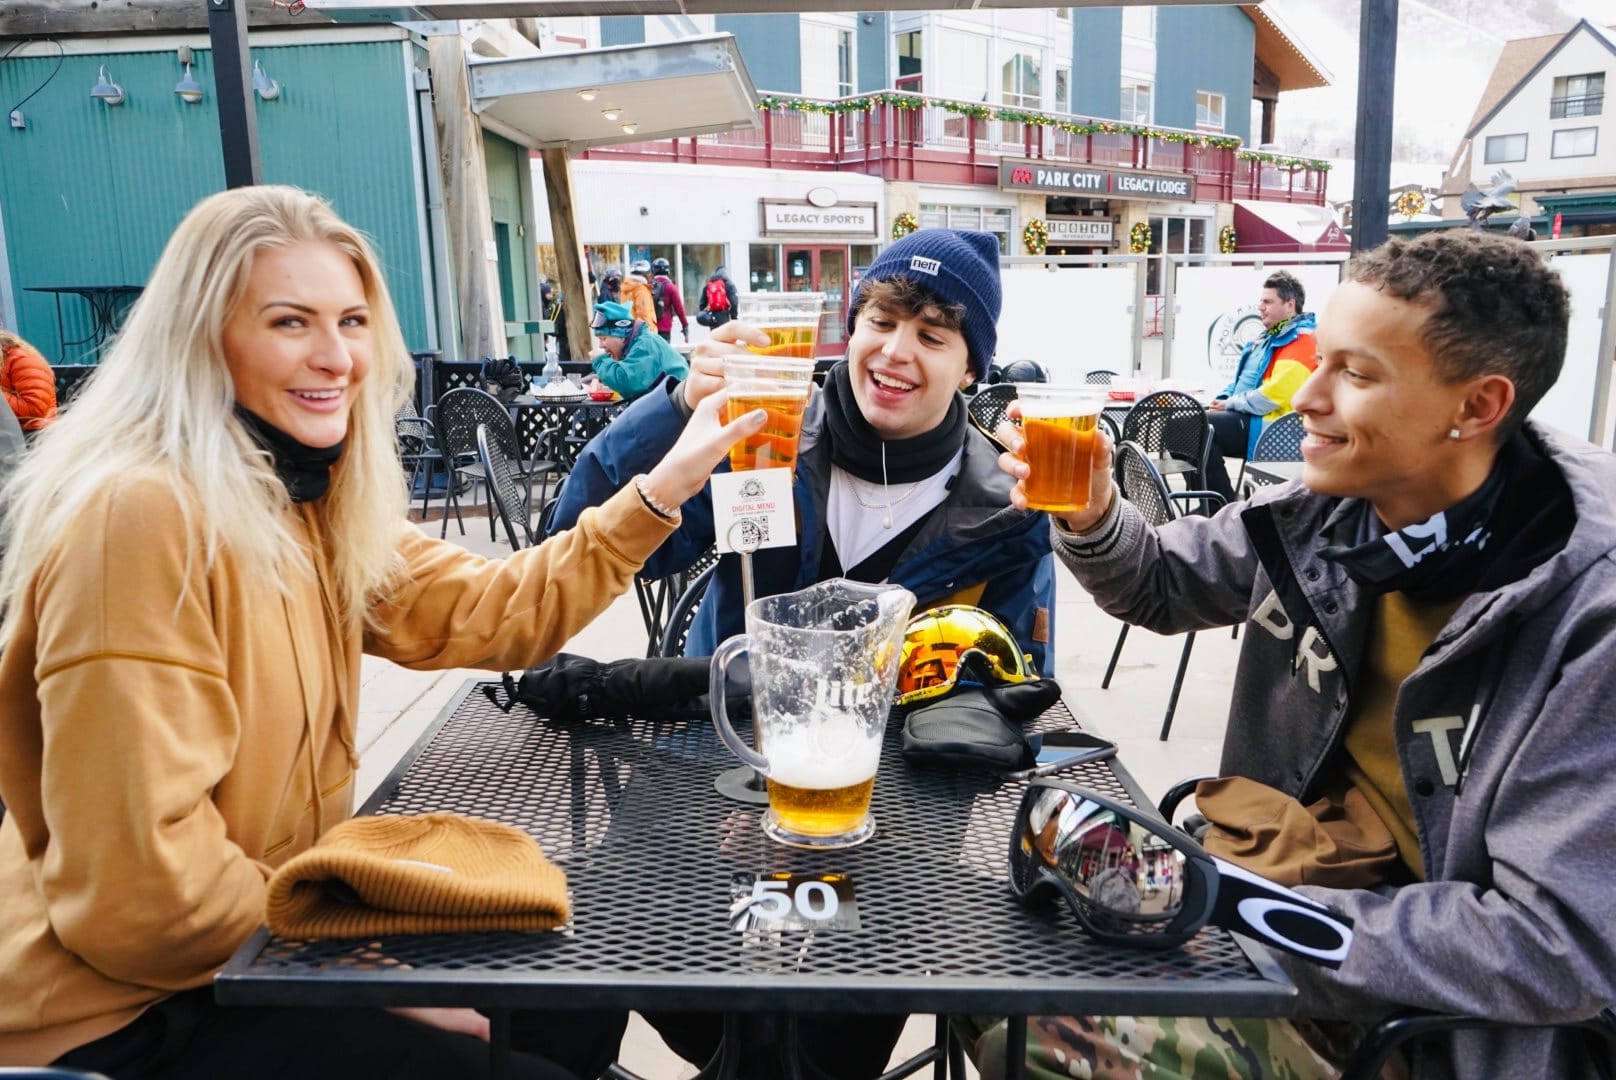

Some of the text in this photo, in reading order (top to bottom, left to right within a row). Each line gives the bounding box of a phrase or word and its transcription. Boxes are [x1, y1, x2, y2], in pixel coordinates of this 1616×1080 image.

[1037, 170, 1187, 195] PARK CITY LEGACY LODGE
[776, 213, 865, 224] LEGACY SPORTS
[732, 504, 755, 512] DIGITAL
[749, 880, 839, 920] 50
